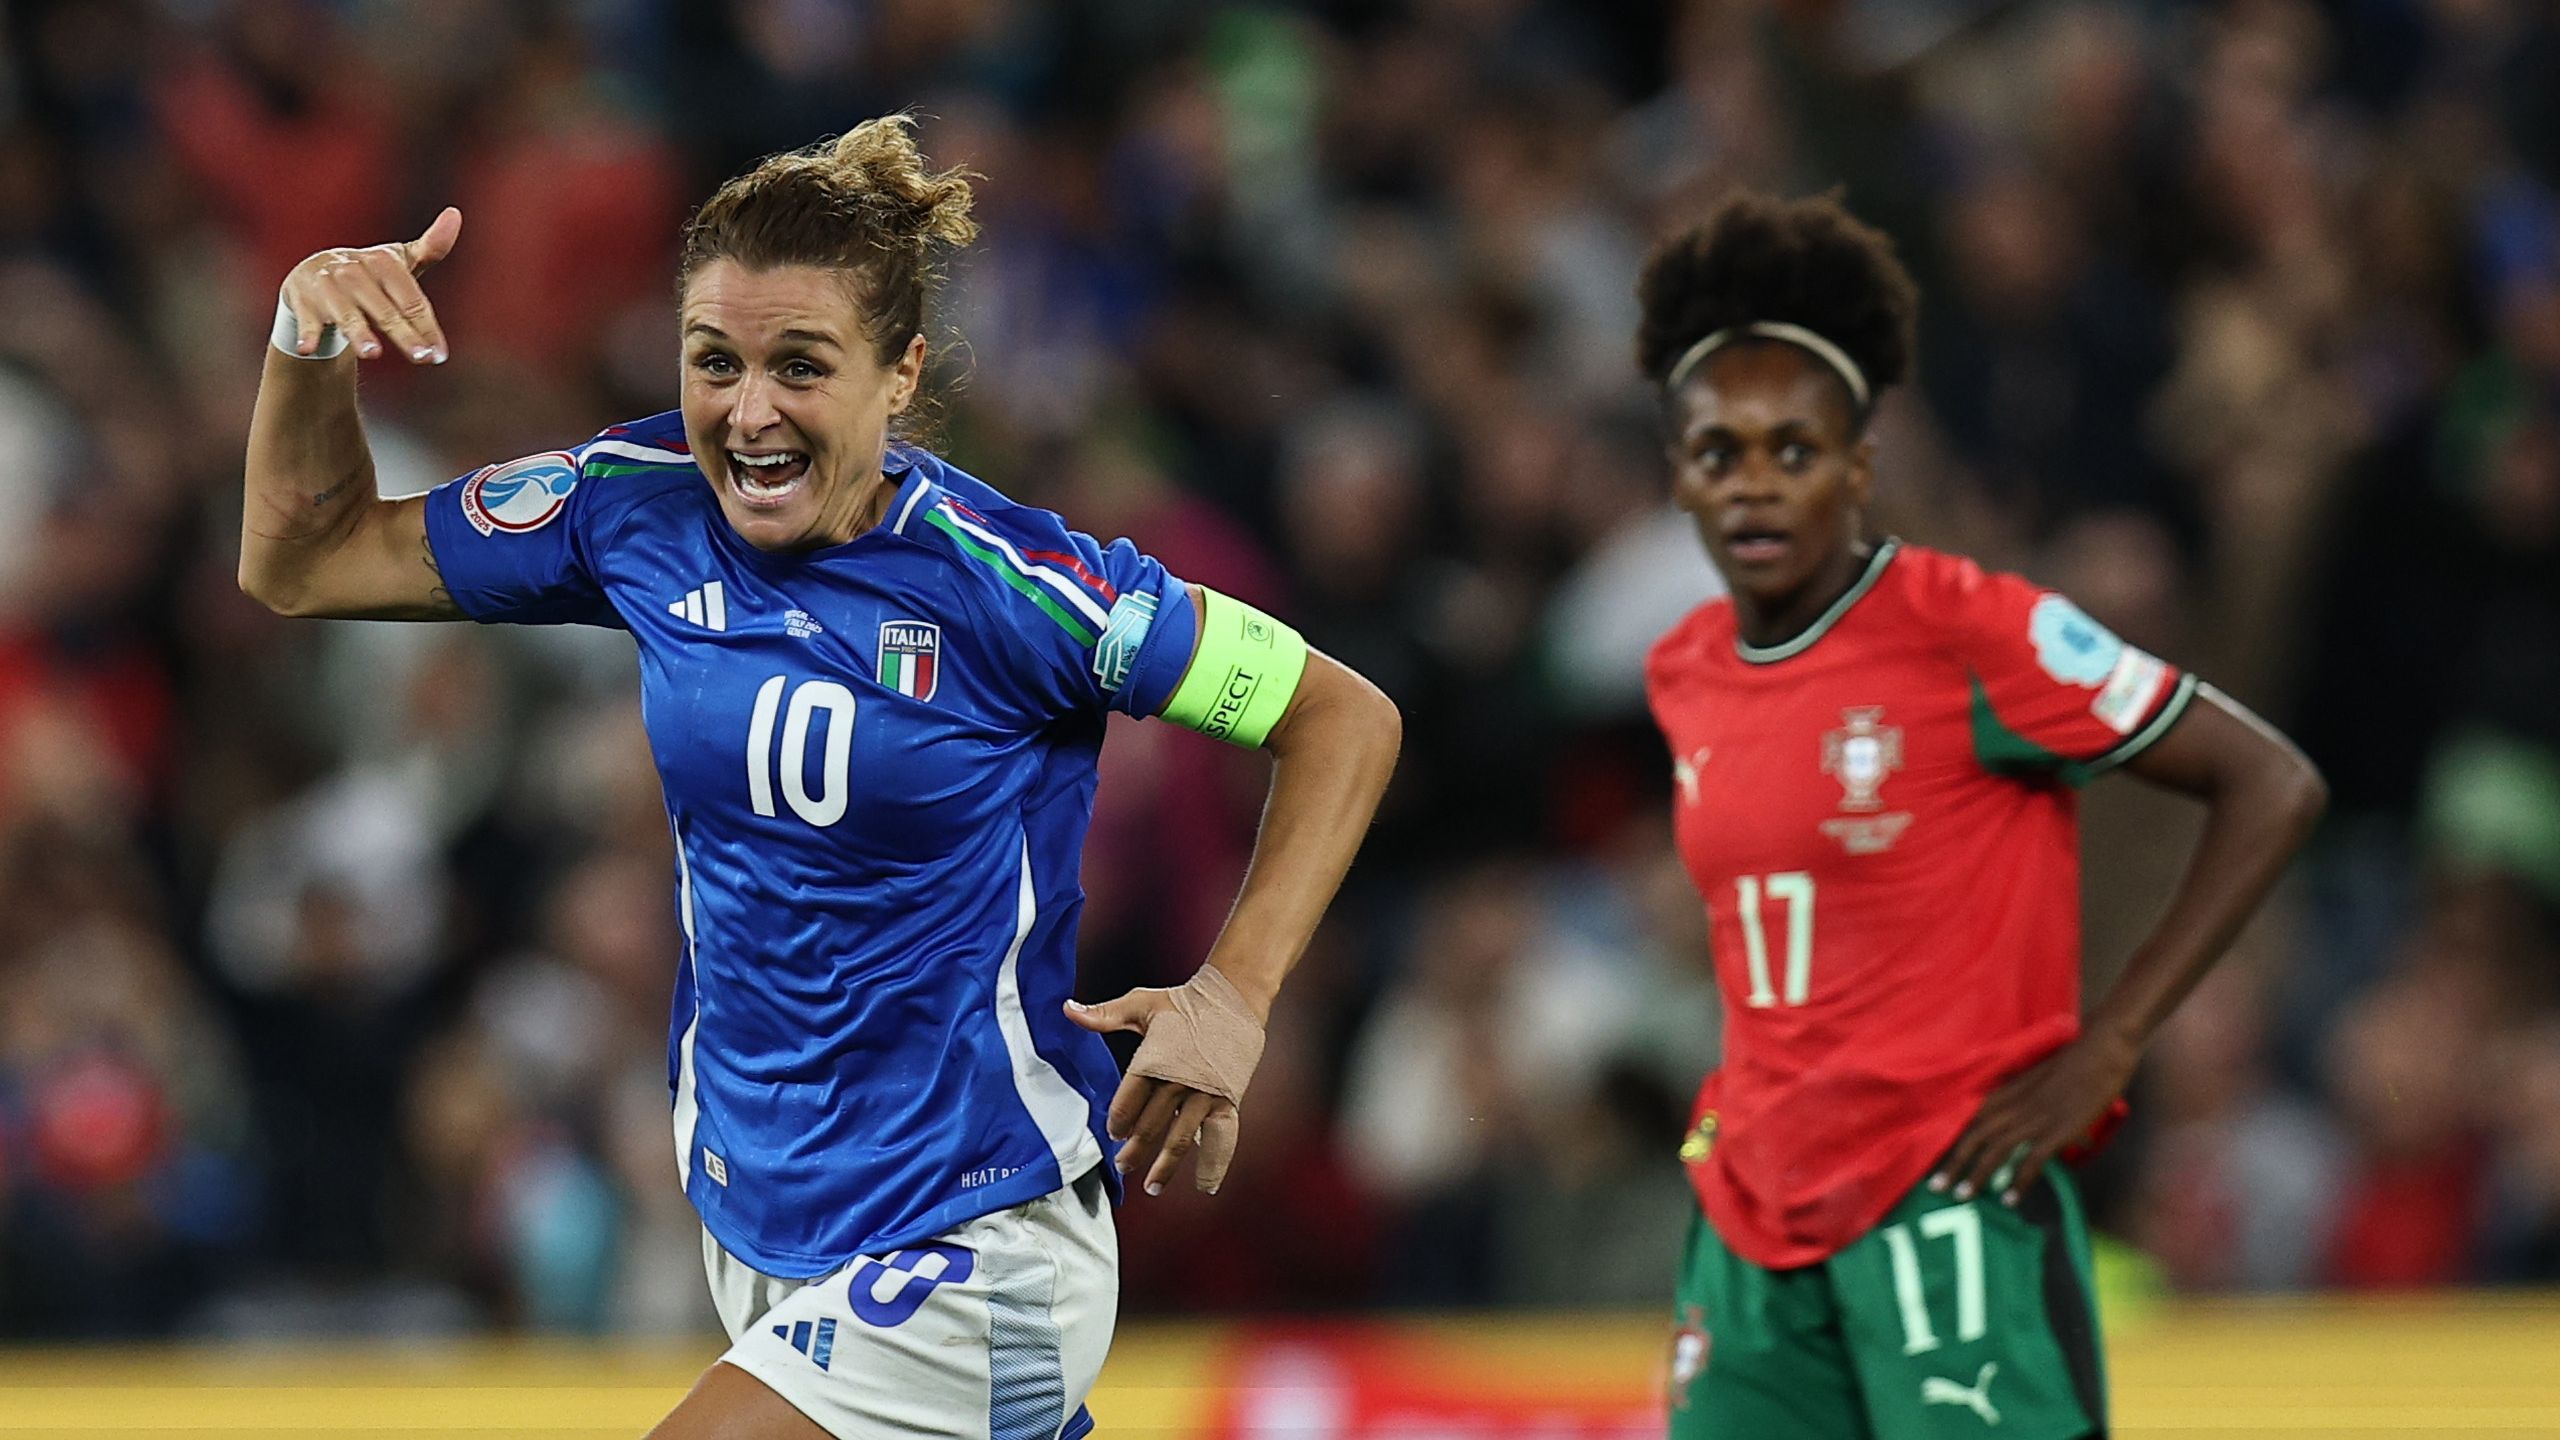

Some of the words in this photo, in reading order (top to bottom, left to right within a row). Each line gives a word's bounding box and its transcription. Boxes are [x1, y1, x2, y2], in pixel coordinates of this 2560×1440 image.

[470, 511, 491, 531] 2025
[884, 627, 934, 647] ITALIA
[1206, 667, 1253, 738] SPECT
[747, 675, 856, 827] 10
[1736, 871, 1815, 1008] 17
[961, 1167, 997, 1188] HEAT
[1882, 1202, 1987, 1356] 17
